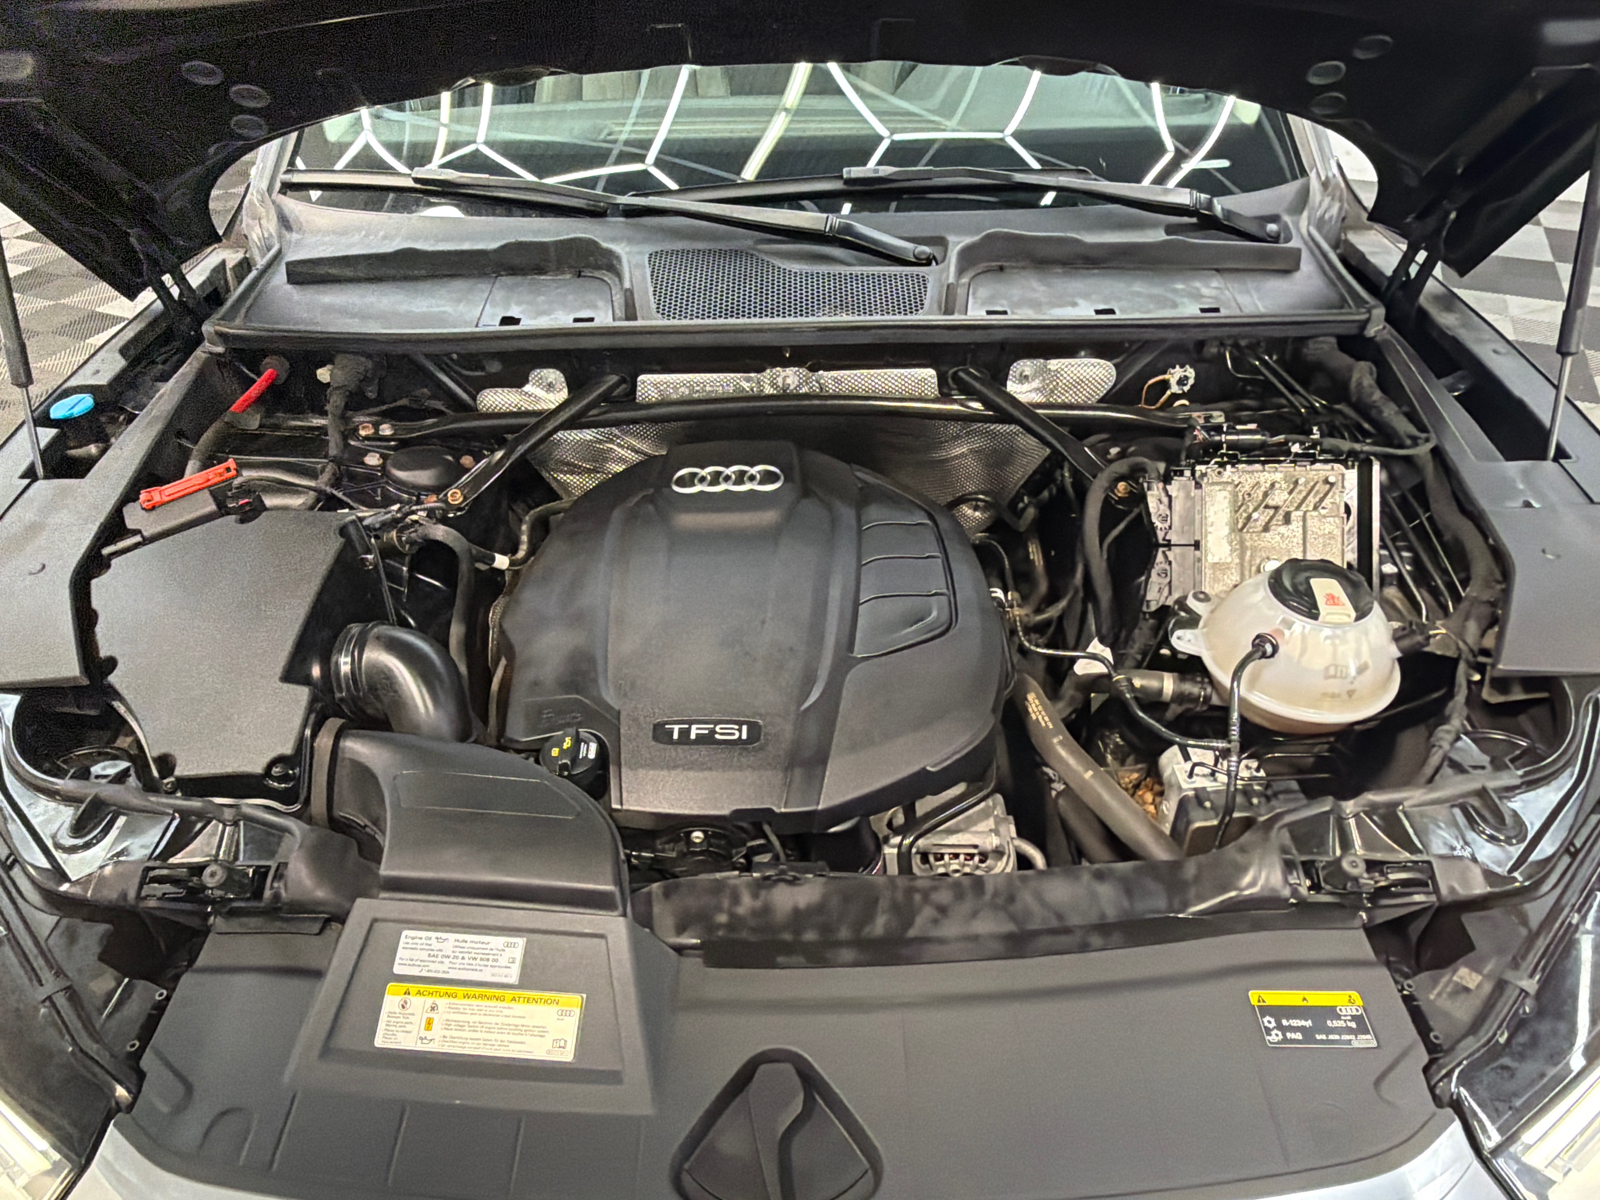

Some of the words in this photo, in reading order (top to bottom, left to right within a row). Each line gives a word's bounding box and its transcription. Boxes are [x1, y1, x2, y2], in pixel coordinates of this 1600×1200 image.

[665, 724, 748, 740] TFSI
[415, 989, 458, 999] ACHTUNG
[462, 992, 505, 1002] WARNING
[510, 995, 560, 1006] ATTENTION
